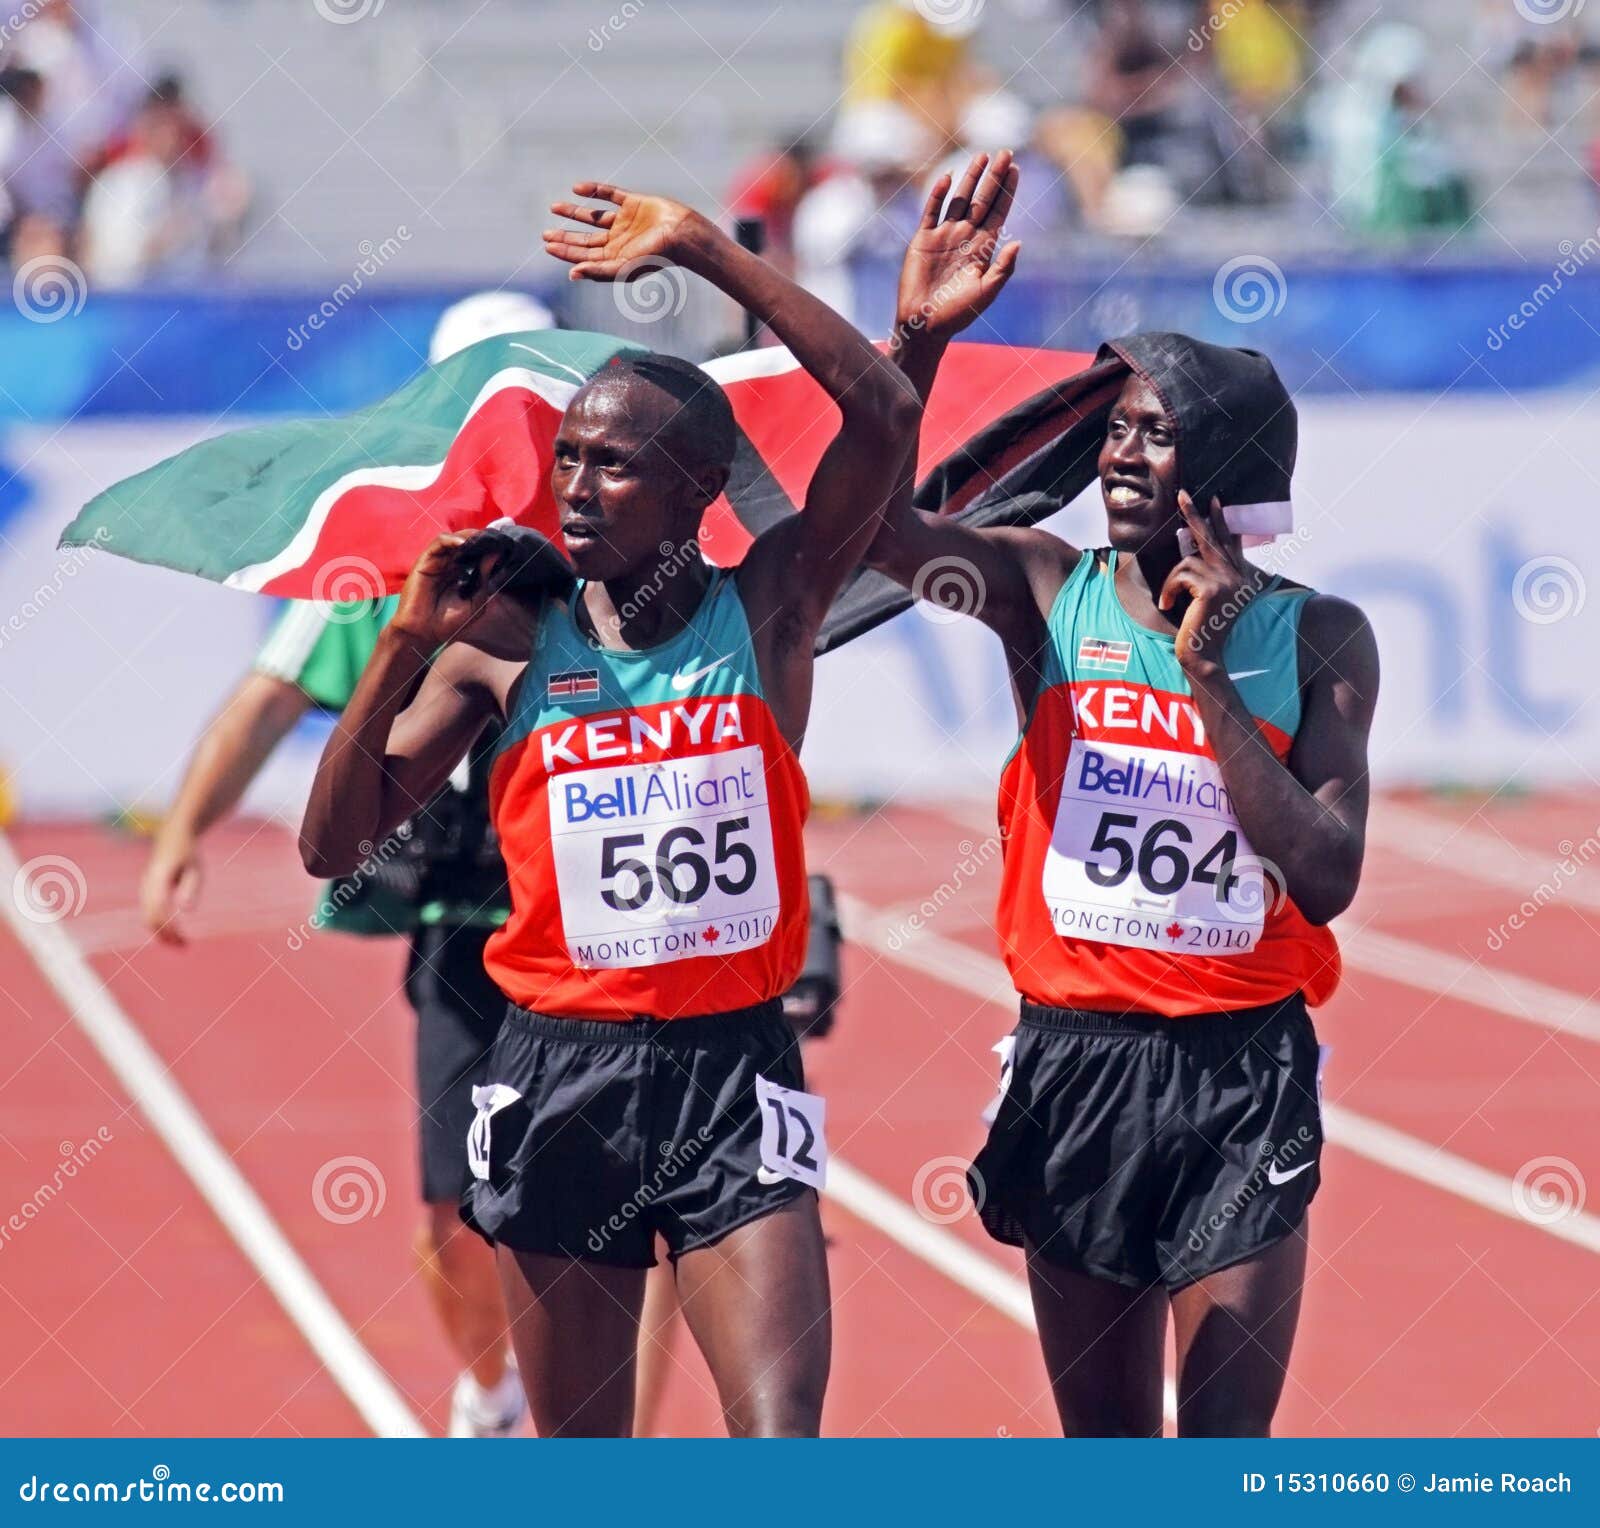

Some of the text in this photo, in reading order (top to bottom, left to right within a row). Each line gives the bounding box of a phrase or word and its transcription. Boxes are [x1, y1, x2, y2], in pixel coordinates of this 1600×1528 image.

[541, 702, 745, 773] KENYA
[1071, 686, 1206, 747] KENY
[600, 816, 757, 911] 565
[1084, 811, 1240, 903] 564
[577, 915, 773, 962] MONCTON 2010
[1187, 925, 1251, 949] 2010
[767, 1097, 818, 1173] 12
